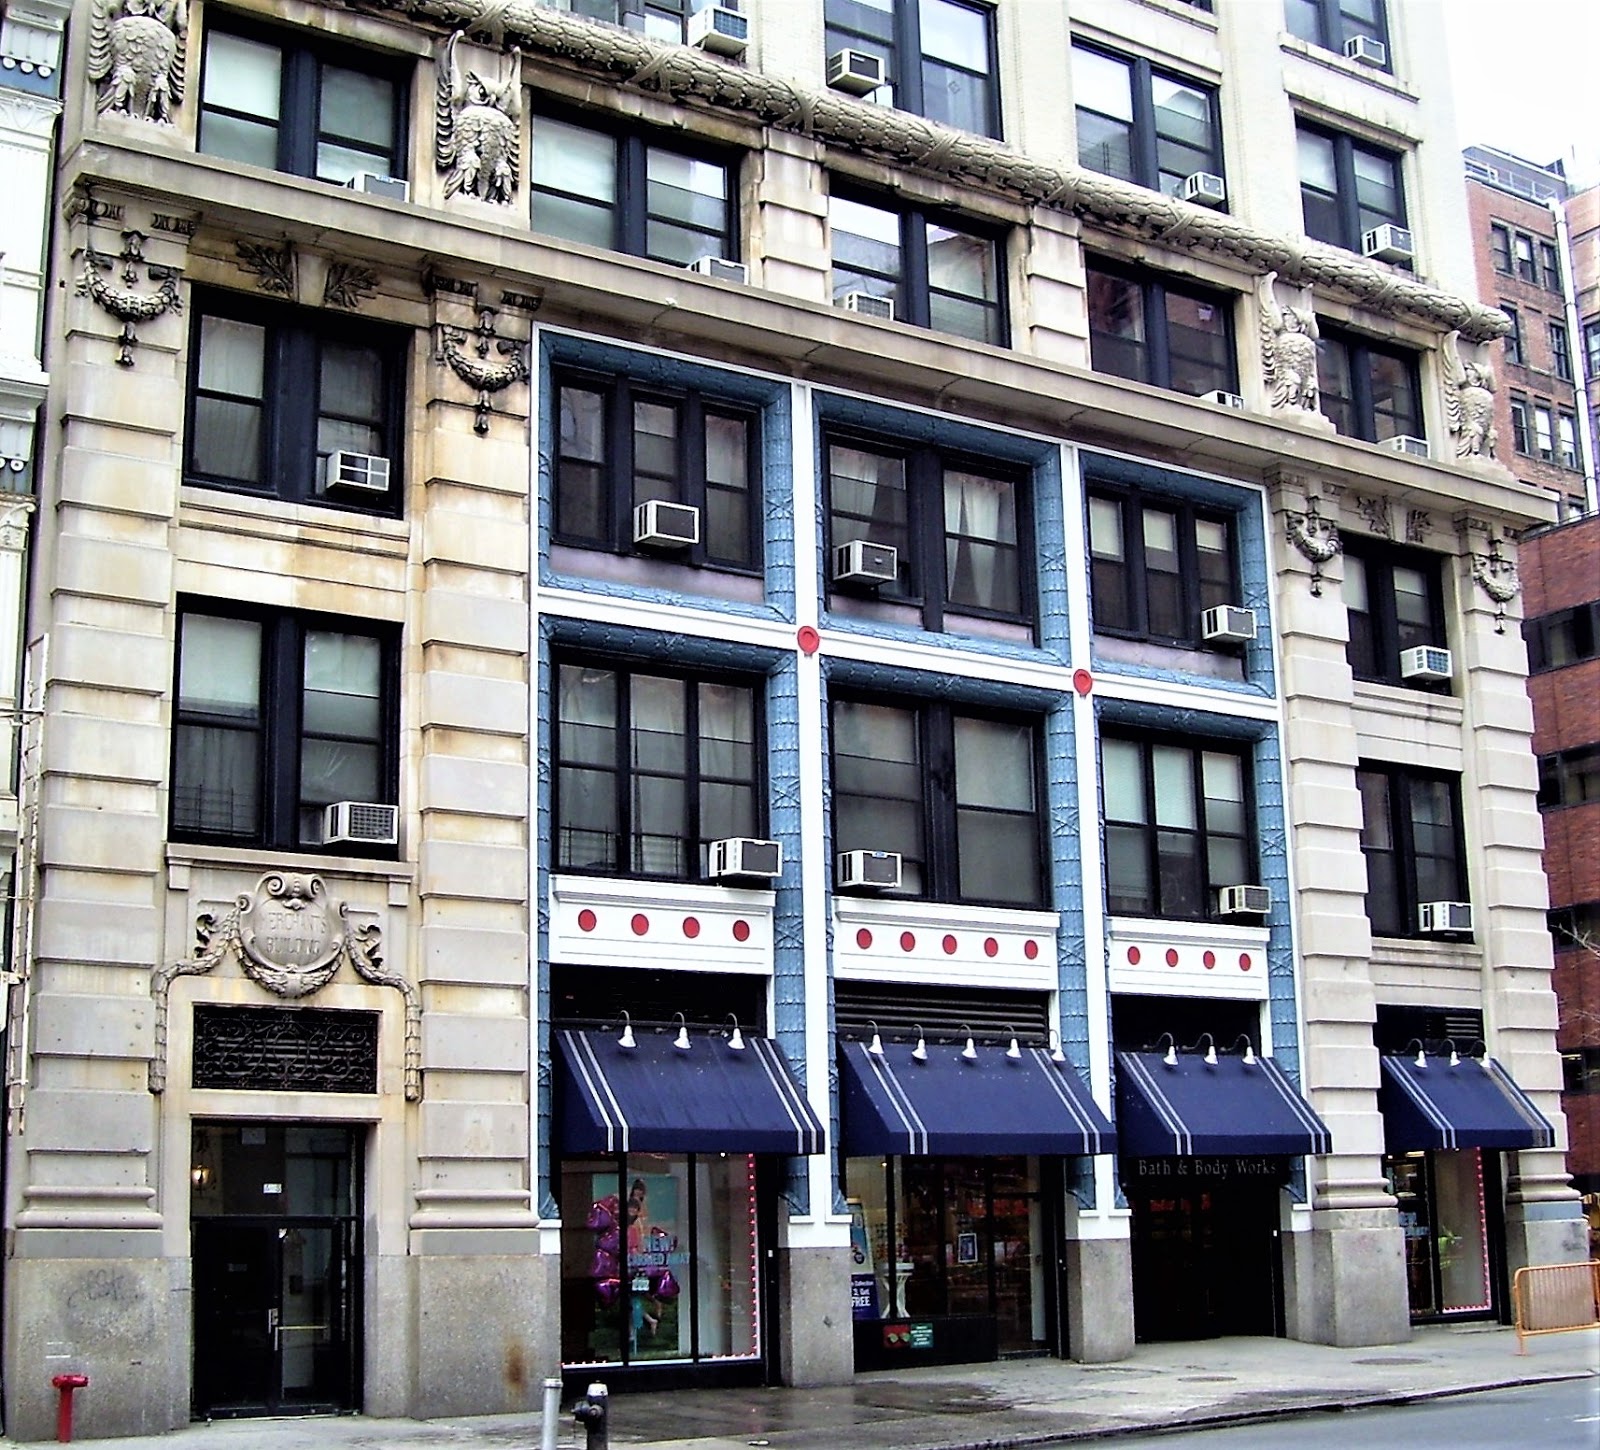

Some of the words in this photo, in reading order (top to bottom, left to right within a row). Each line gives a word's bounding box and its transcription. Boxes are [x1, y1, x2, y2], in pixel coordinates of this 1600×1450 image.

[1138, 1159, 1172, 1176] Bath
[1177, 1160, 1188, 1175] &
[1194, 1159, 1229, 1180] Body
[1235, 1159, 1276, 1174] Works
[851, 1296, 871, 1307] FREE
